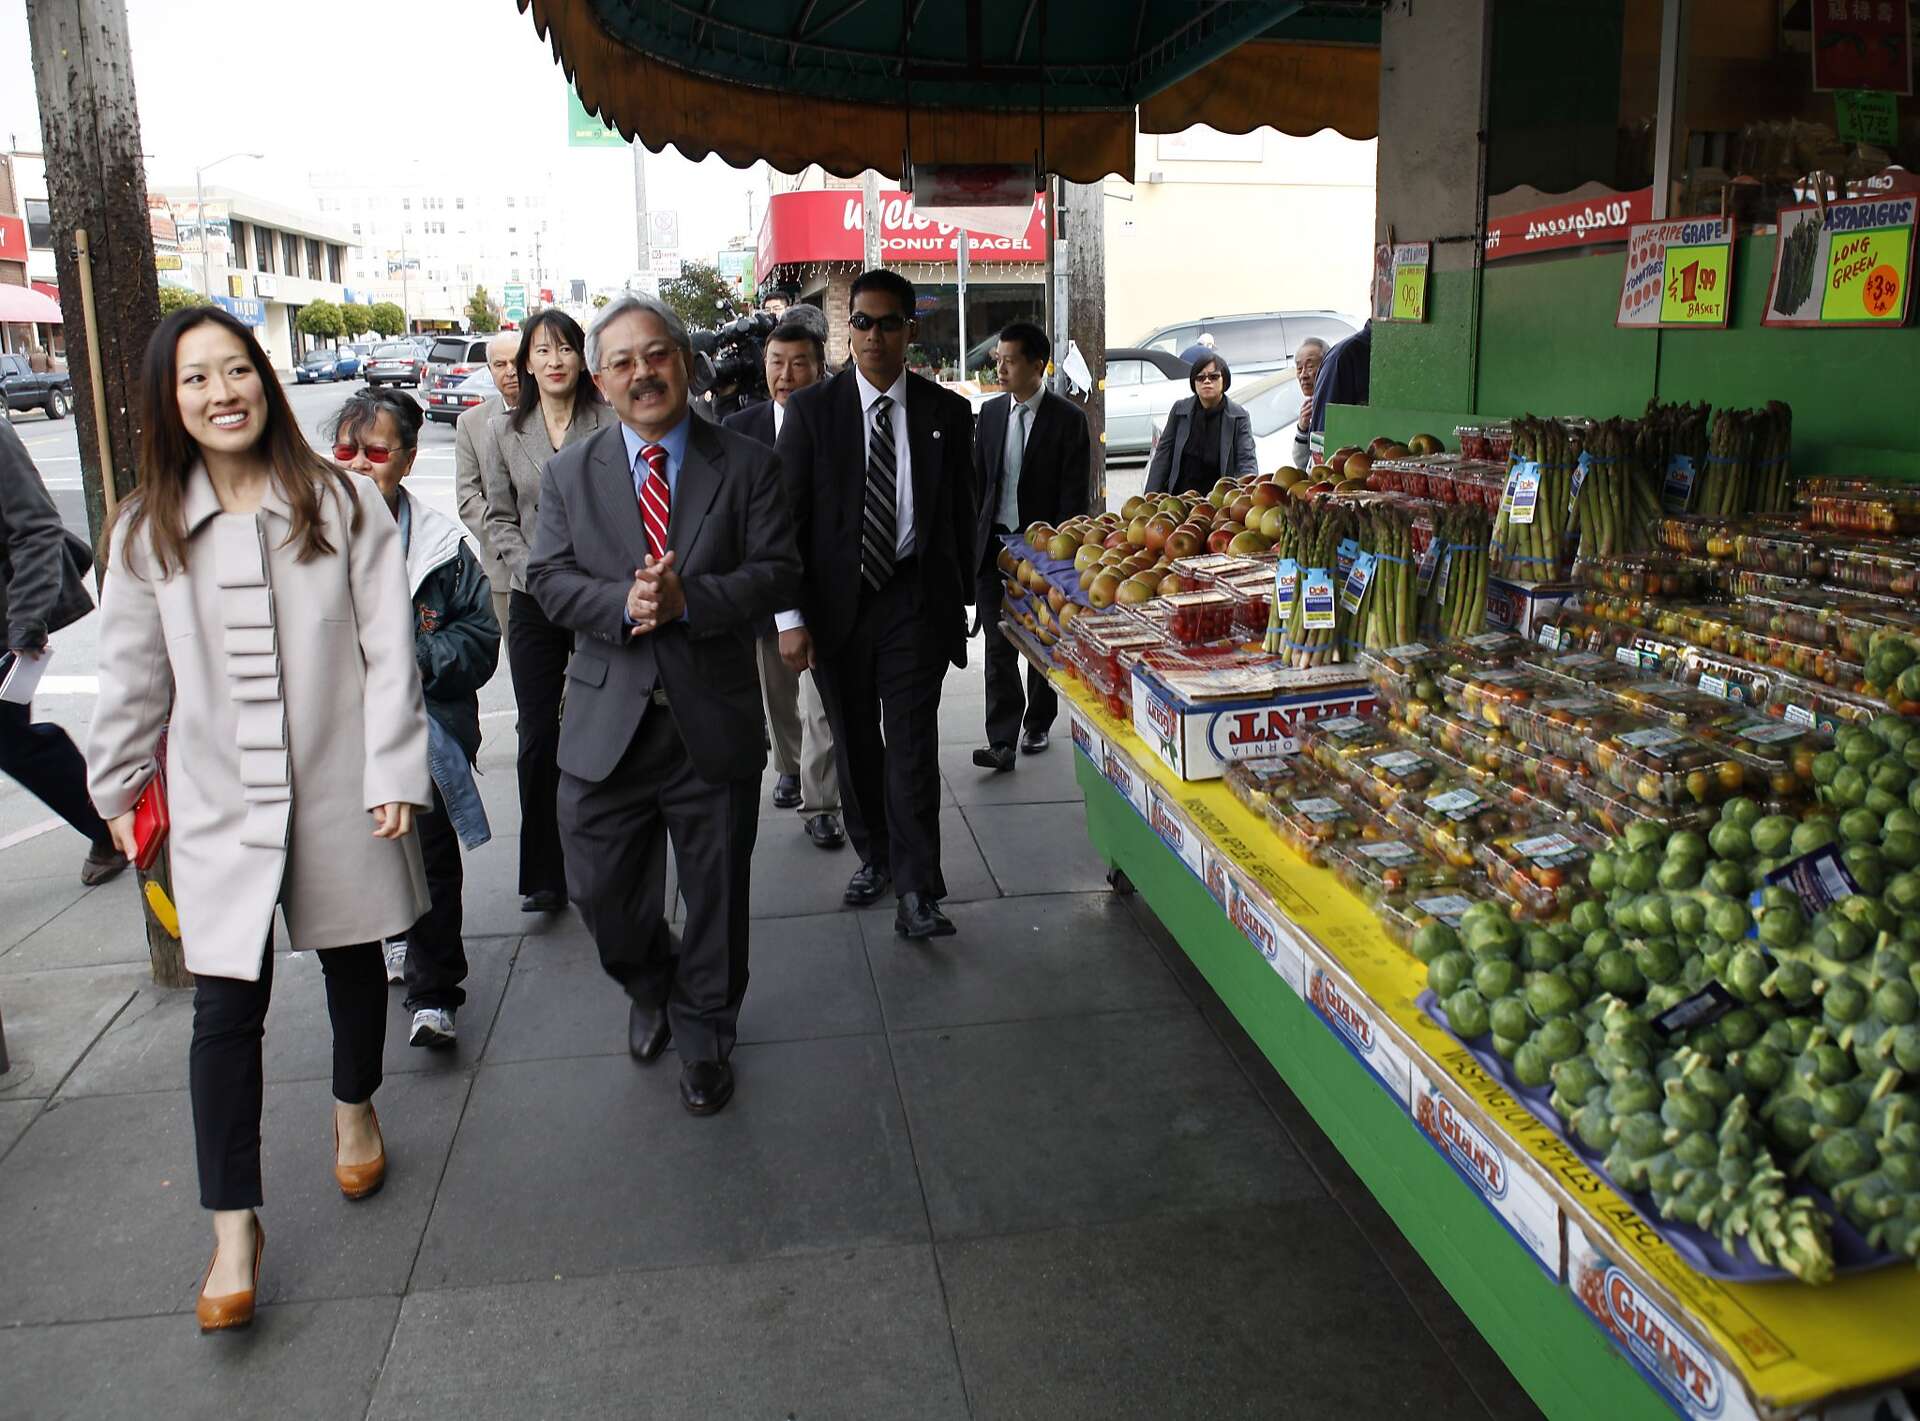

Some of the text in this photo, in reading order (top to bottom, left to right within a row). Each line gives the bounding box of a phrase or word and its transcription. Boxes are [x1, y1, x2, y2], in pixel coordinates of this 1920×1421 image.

[1823, 202, 1912, 231] ASPARAGUS
[880, 238, 944, 249] DONUT
[969, 238, 1032, 250] BAGEL
[1681, 222, 1722, 244] GRAPE
[1833, 236, 1871, 266] LONG
[1626, 260, 1664, 292] TOMATOES
[1832, 251, 1879, 289] GREEN
[1686, 302, 1721, 318] BASKET
[1309, 586, 1329, 596] Dole
[1232, 740, 1294, 757] ORNIA
[1240, 899, 1274, 955] GIANT
[1325, 977, 1371, 1044] GIANT
[1438, 1101, 1500, 1188] GIANT
[1611, 1278, 1712, 1404] GIANT
